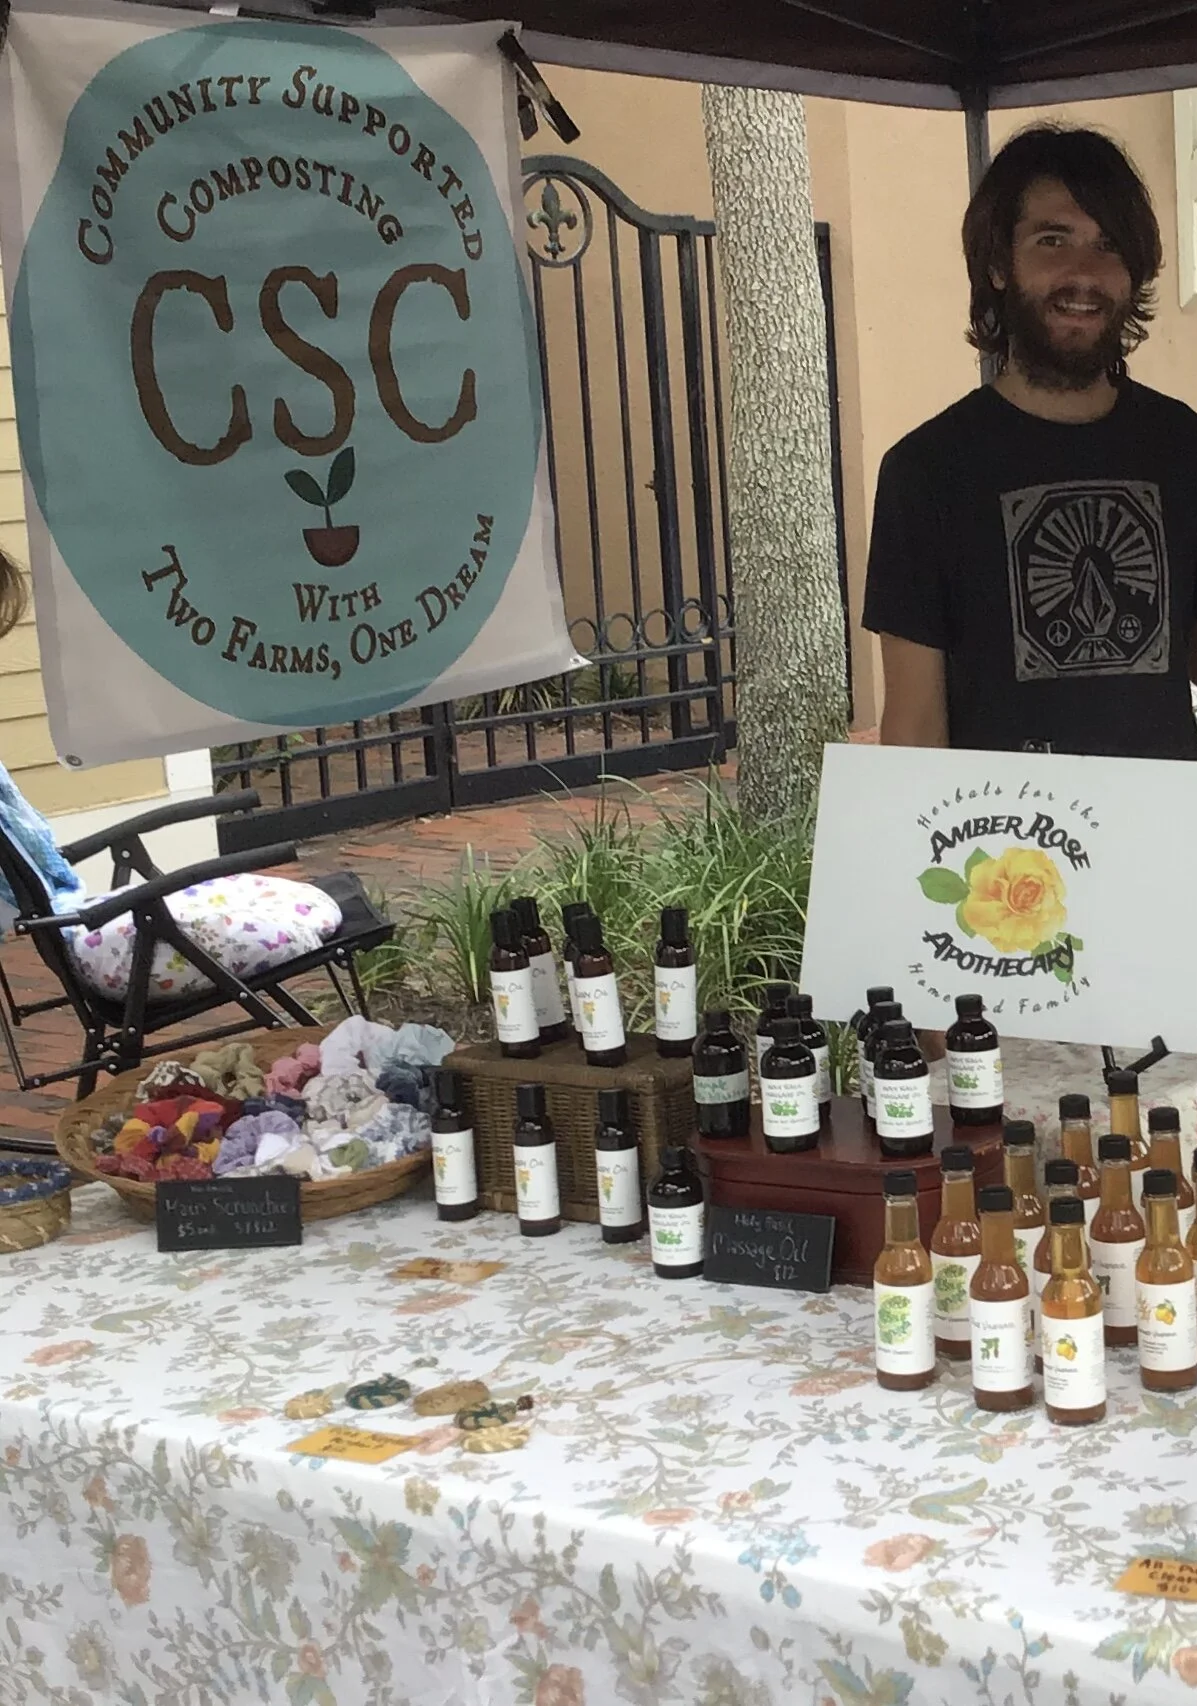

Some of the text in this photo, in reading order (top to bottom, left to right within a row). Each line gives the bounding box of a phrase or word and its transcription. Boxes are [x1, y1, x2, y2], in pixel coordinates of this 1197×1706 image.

[78, 66, 483, 265] COMMUNITY SUPPORTED
[157, 156, 403, 246] COMPOSTING
[130, 264, 477, 466] CSC
[141, 513, 494, 678] TWO FARMS, ONE DREAM
[292, 582, 382, 623] WITH
[917, 781, 1099, 829] Herbals for the
[930, 812, 1091, 871] AMBER ROSE
[922, 930, 1074, 977] APOTHECARY
[1019, 976, 1090, 1014] Family
[712, 1232, 809, 1269] Massage Oil
